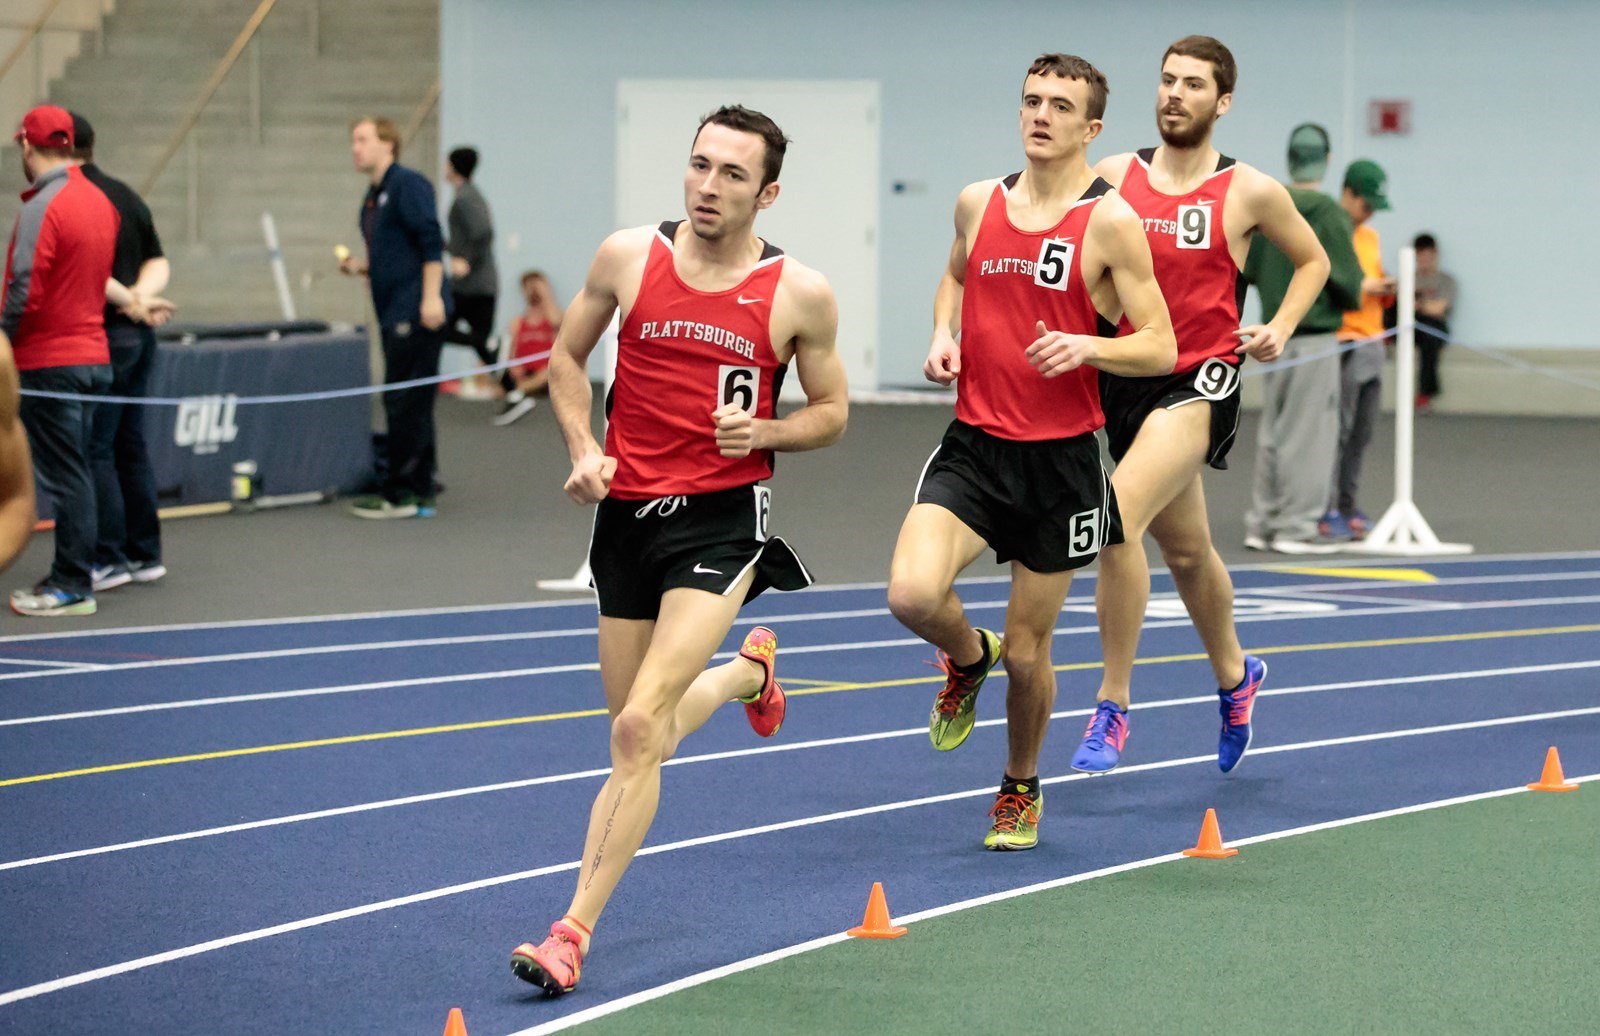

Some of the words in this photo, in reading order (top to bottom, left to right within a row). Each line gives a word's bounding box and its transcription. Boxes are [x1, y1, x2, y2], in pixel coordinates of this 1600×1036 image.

[1182, 208, 1206, 245] 9
[1039, 242, 1067, 285] 5
[639, 320, 756, 360] PLATTSBURGH
[723, 368, 754, 413] 6
[1201, 361, 1228, 395] 9
[174, 393, 239, 447] GILL
[1073, 512, 1095, 553] 5
